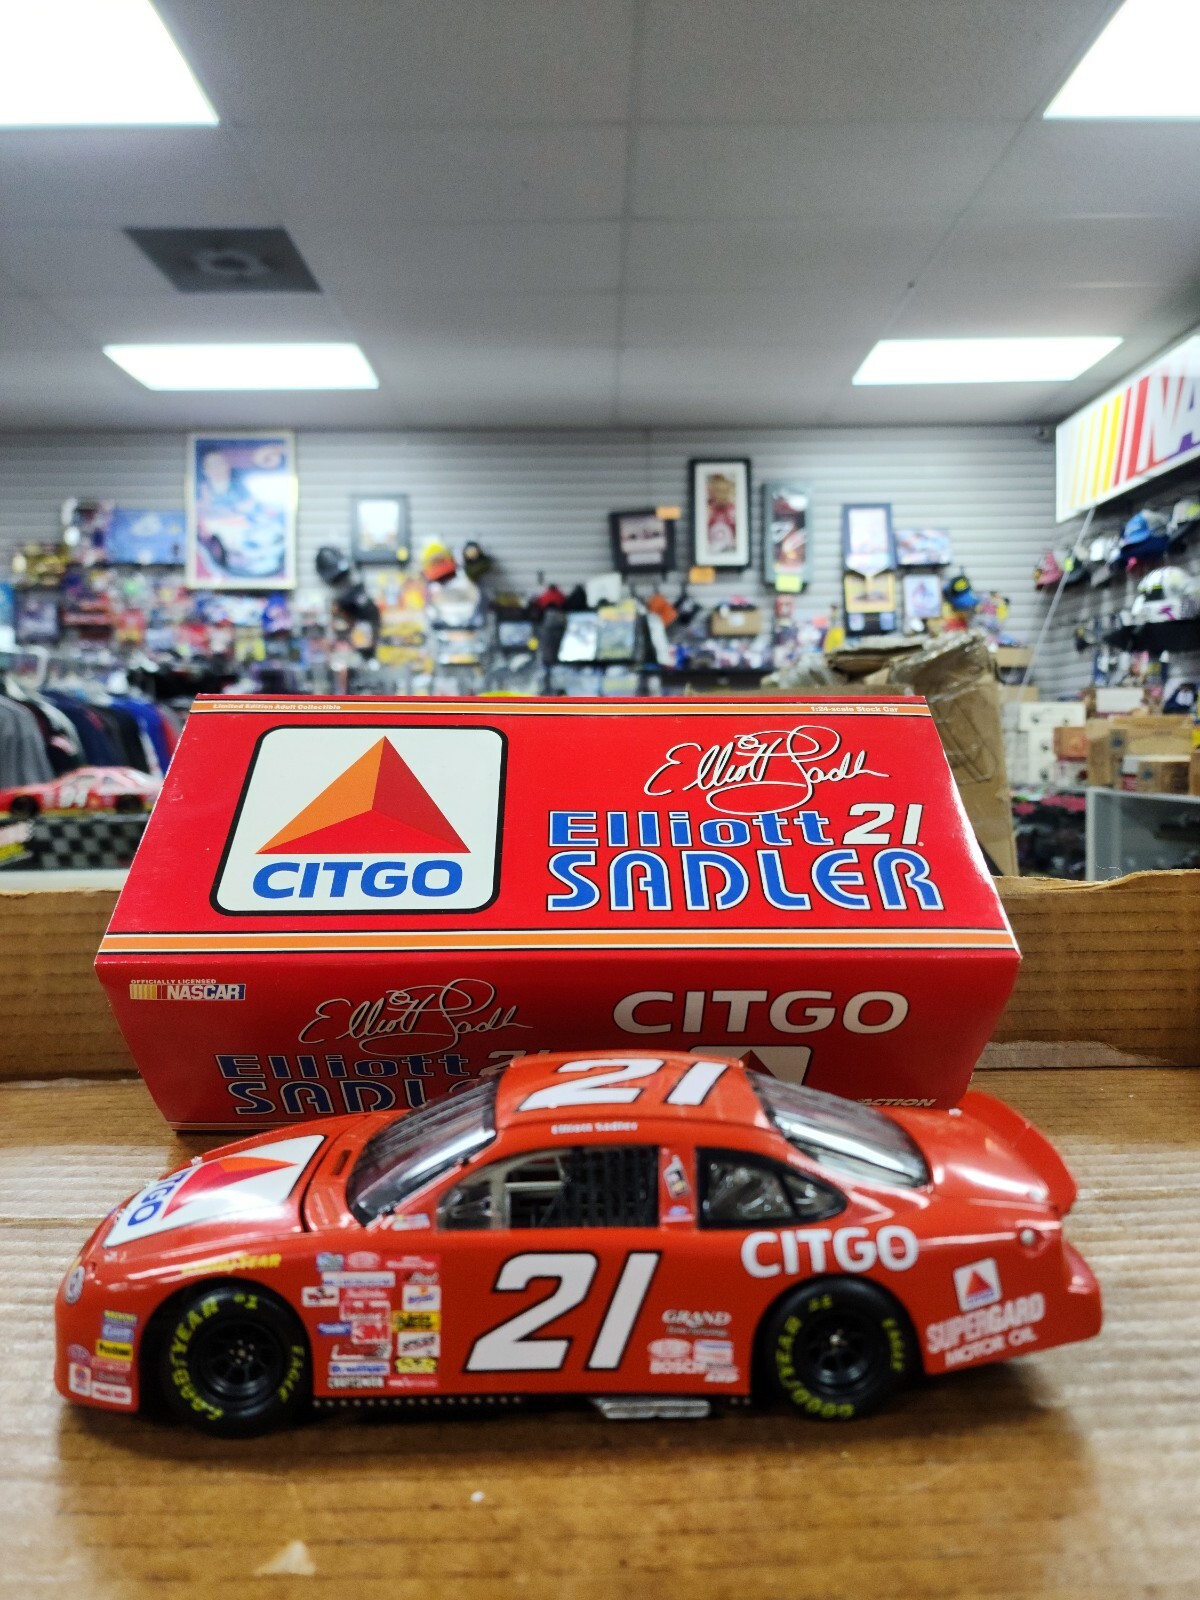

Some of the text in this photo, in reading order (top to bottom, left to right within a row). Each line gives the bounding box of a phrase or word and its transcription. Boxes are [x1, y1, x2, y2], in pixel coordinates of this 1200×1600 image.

[548, 802, 924, 848] Elliott 21
[252, 859, 463, 900] CITGO
[546, 848, 945, 912] SADLER
[166, 984, 241, 1000] NASCAR
[612, 990, 910, 1035] CITGO
[214, 1054, 473, 1080] Elliott
[516, 1058, 728, 1112] 21
[857, 1098, 937, 1107] ACTION
[741, 1225, 919, 1278] CITGO
[465, 1250, 662, 1373] 21
[926, 1292, 1046, 1354] SUPERGARD
[169, 1297, 224, 1421] GOODYEAR
[945, 1325, 1038, 1367] MOTOR OIL
